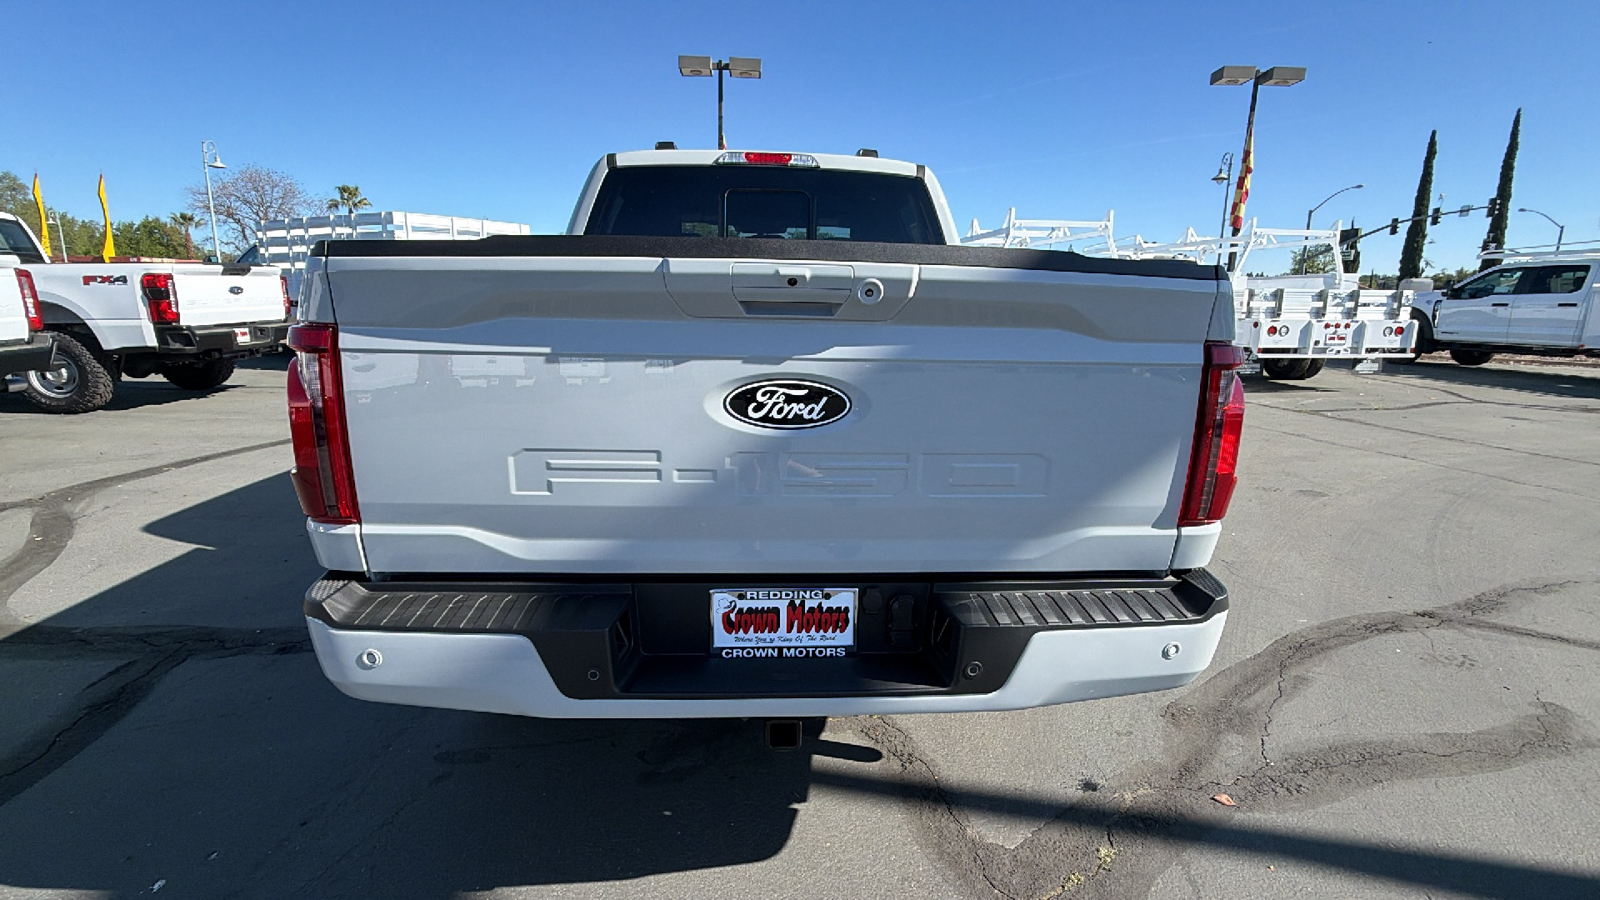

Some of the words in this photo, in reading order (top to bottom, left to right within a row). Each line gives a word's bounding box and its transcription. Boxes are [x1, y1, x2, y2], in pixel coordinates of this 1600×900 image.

[82, 275, 128, 286] FX4
[747, 386, 829, 420] Ford
[507, 448, 1052, 498] F-150
[746, 590, 823, 600] REDDING
[721, 601, 781, 635] Crown
[785, 600, 850, 634] Motors
[794, 635, 804, 643] Of
[819, 634, 837, 642] Road
[721, 647, 779, 659] CROWN
[782, 647, 846, 658] MOTORS
